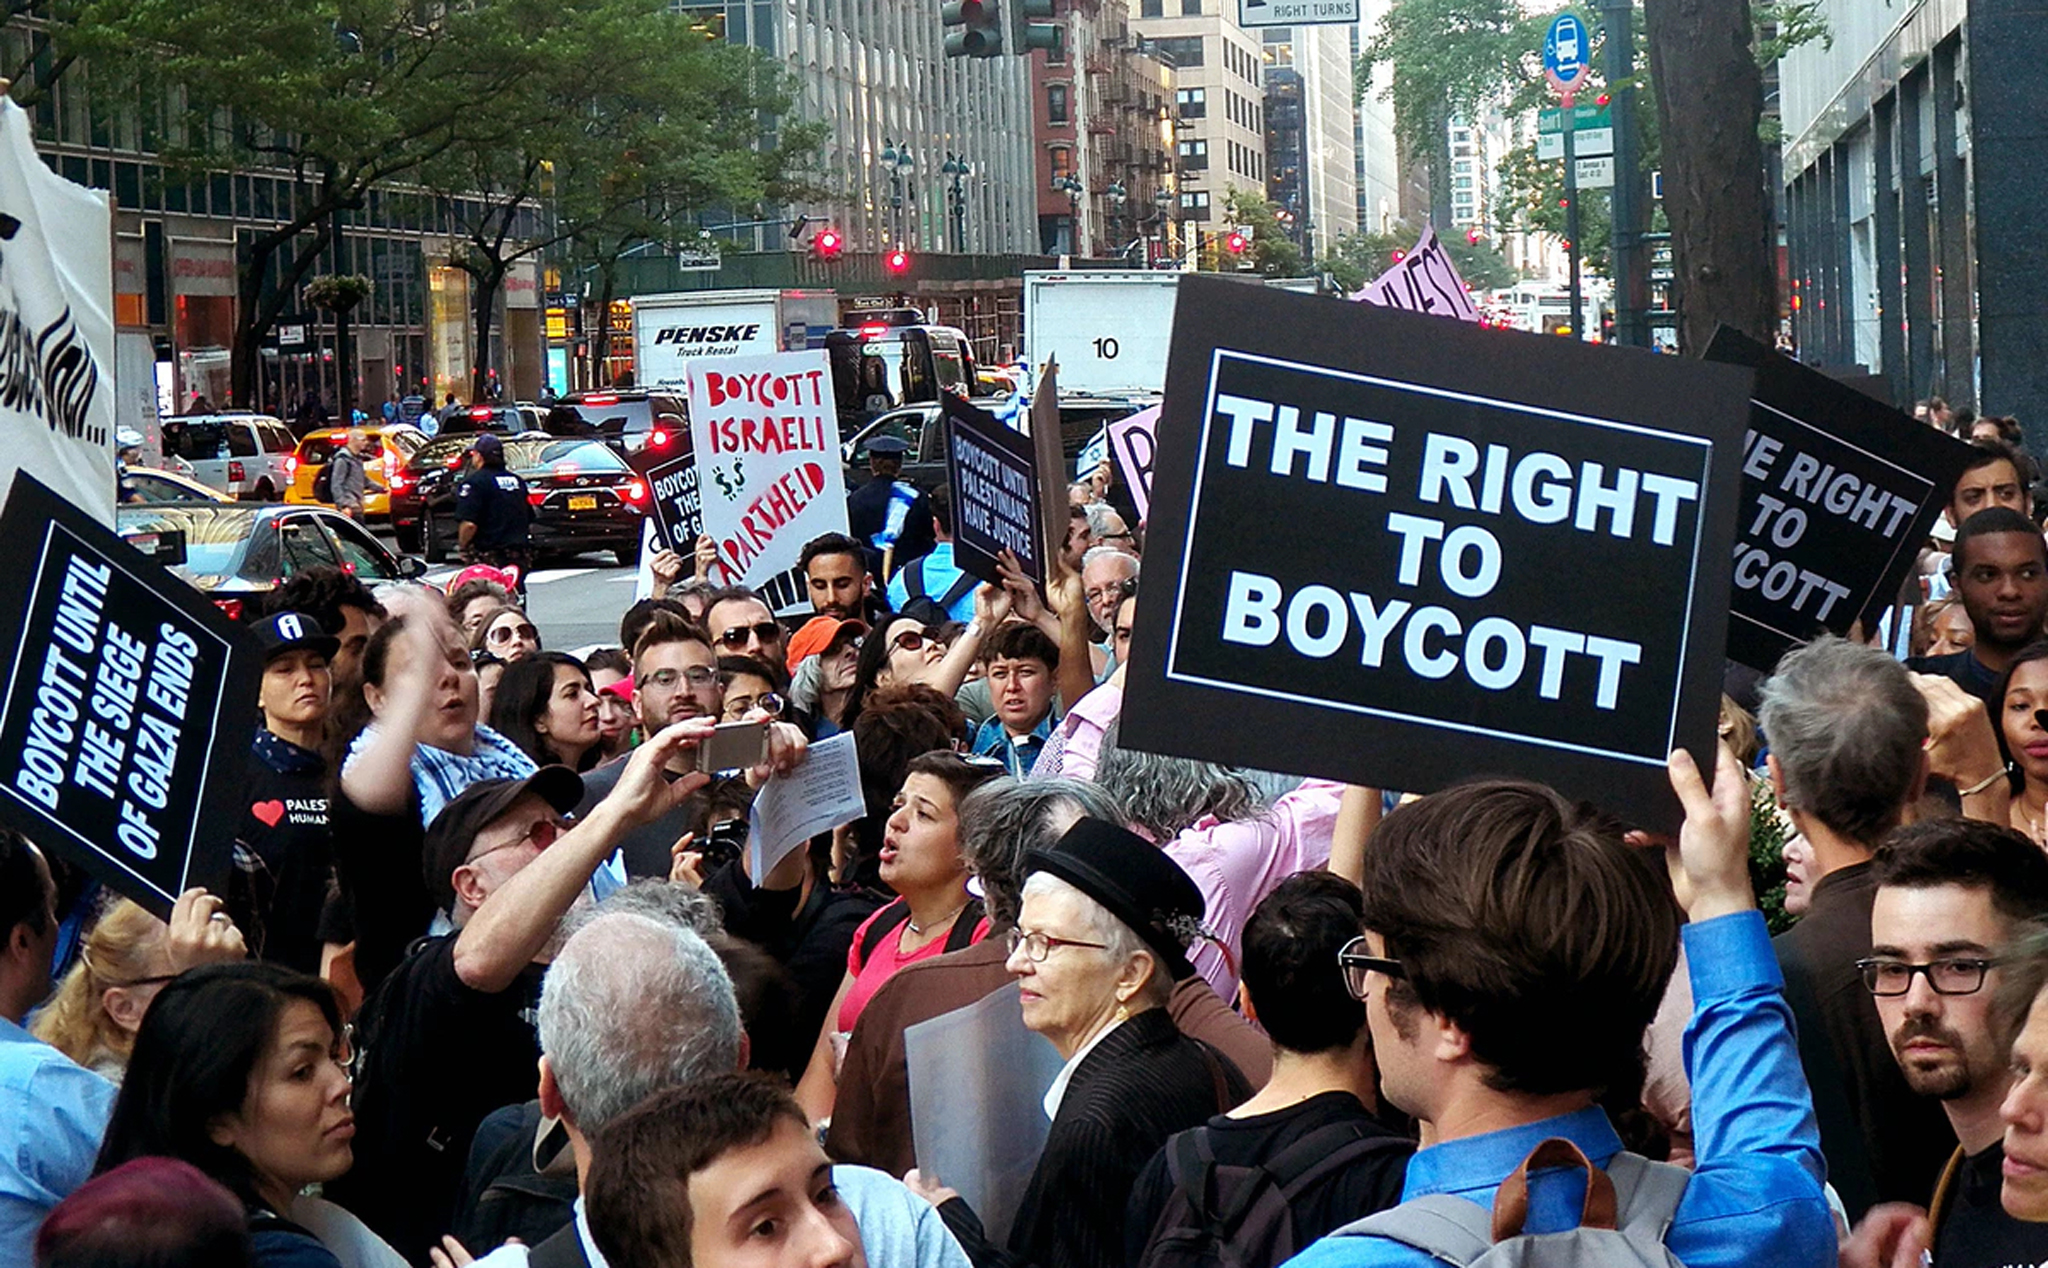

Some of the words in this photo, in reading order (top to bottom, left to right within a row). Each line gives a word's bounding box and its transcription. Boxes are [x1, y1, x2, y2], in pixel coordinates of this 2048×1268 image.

[1274, 4, 1307, 17] RIGHT
[1314, 3, 1352, 16] TURNS
[1381, 233, 1472, 318] VEST
[655, 324, 760, 345] PENSKE
[677, 347, 703, 357] Truck
[705, 345, 739, 356] Rental
[1092, 337, 1119, 359] 10
[705, 371, 823, 408] BOYCOTT
[710, 416, 825, 454] ISRAELI
[654, 465, 698, 500] BOYCO
[955, 434, 1000, 483] BOYCOTT
[1001, 463, 1031, 501] UNTIL
[961, 467, 1030, 529] PALESTINIANS
[1217, 394, 1395, 493] THE
[1419, 433, 1698, 546] RIGHT
[1780, 452, 1917, 538] RIGHT
[673, 520, 690, 544] OF
[674, 491, 700, 517] THE
[718, 462, 825, 586] APARTHEID
[963, 498, 991, 536] HAVE
[993, 516, 1032, 560] JUSTICE
[1750, 493, 1808, 548] TO
[1387, 511, 1502, 598] TO
[1733, 542, 1850, 622] COTT
[1222, 571, 1641, 709] BOYCOTT
[16, 643, 87, 811] BOYCOTT
[53, 554, 113, 654] UNTIL
[91, 622, 147, 731] SIEGE
[147, 623, 198, 721] ENDS
[74, 720, 126, 799] THE
[128, 713, 181, 809] GAZA
[117, 800, 160, 860] OF
[286, 799, 329, 811] PALES
